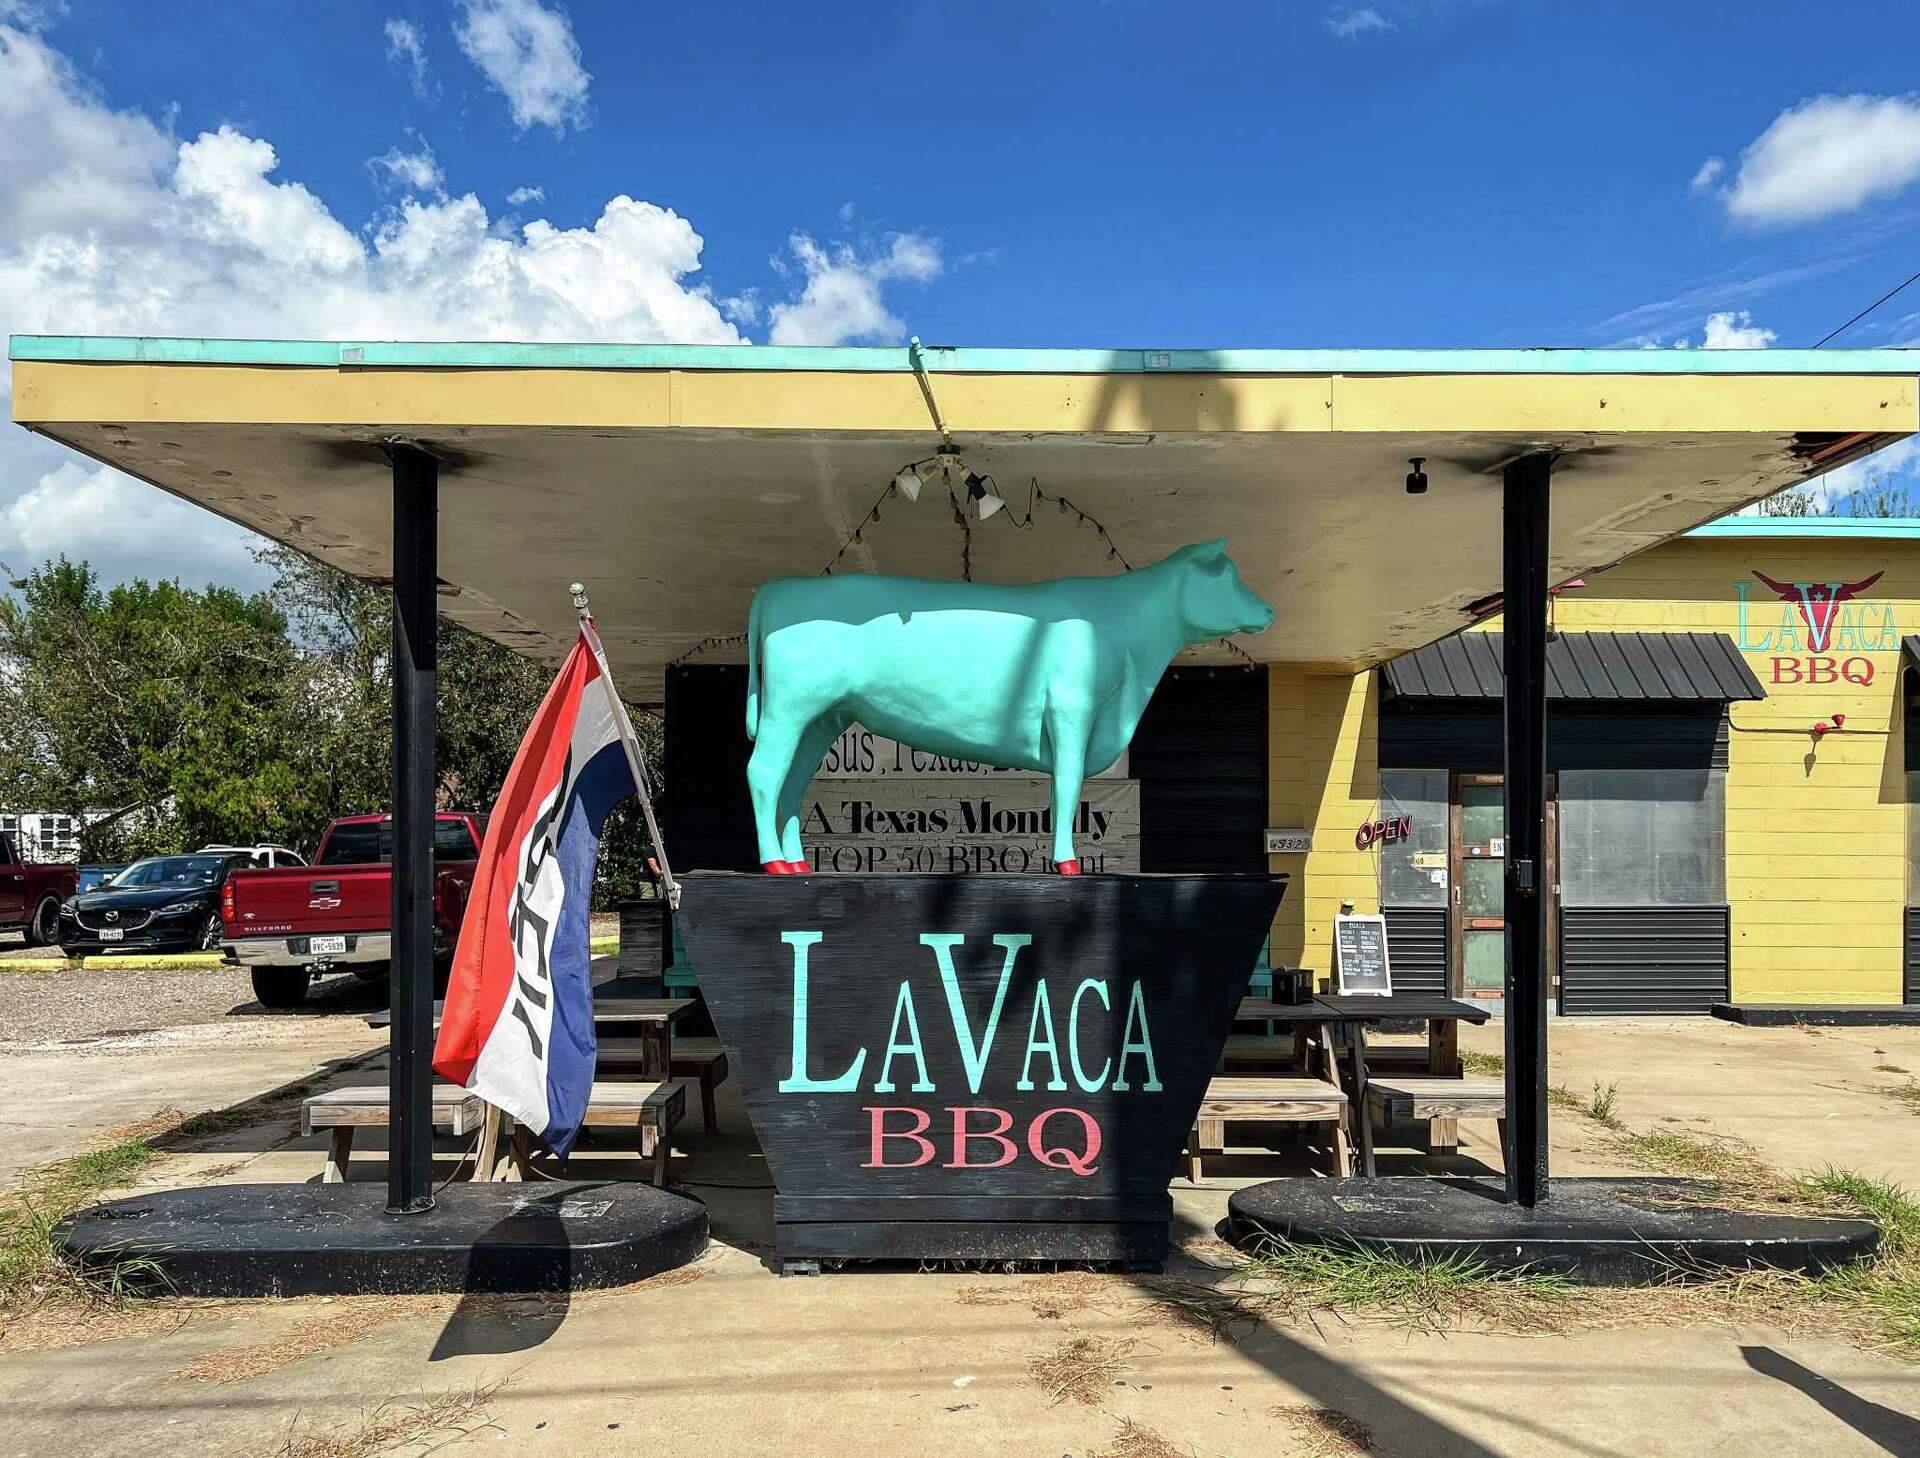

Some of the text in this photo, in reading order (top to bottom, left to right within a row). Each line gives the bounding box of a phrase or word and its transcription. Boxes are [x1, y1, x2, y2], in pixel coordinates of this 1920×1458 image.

[1770, 657, 1875, 687] BBQ
[818, 731, 886, 775] sus,
[801, 801, 1116, 841] A Texas Montly
[1358, 814, 1413, 847] OPEN
[804, 846, 888, 872] TOP
[1041, 846, 1105, 872] jnt
[243, 924, 293, 932] SILVERADO
[860, 1106, 1102, 1176] BBQ
